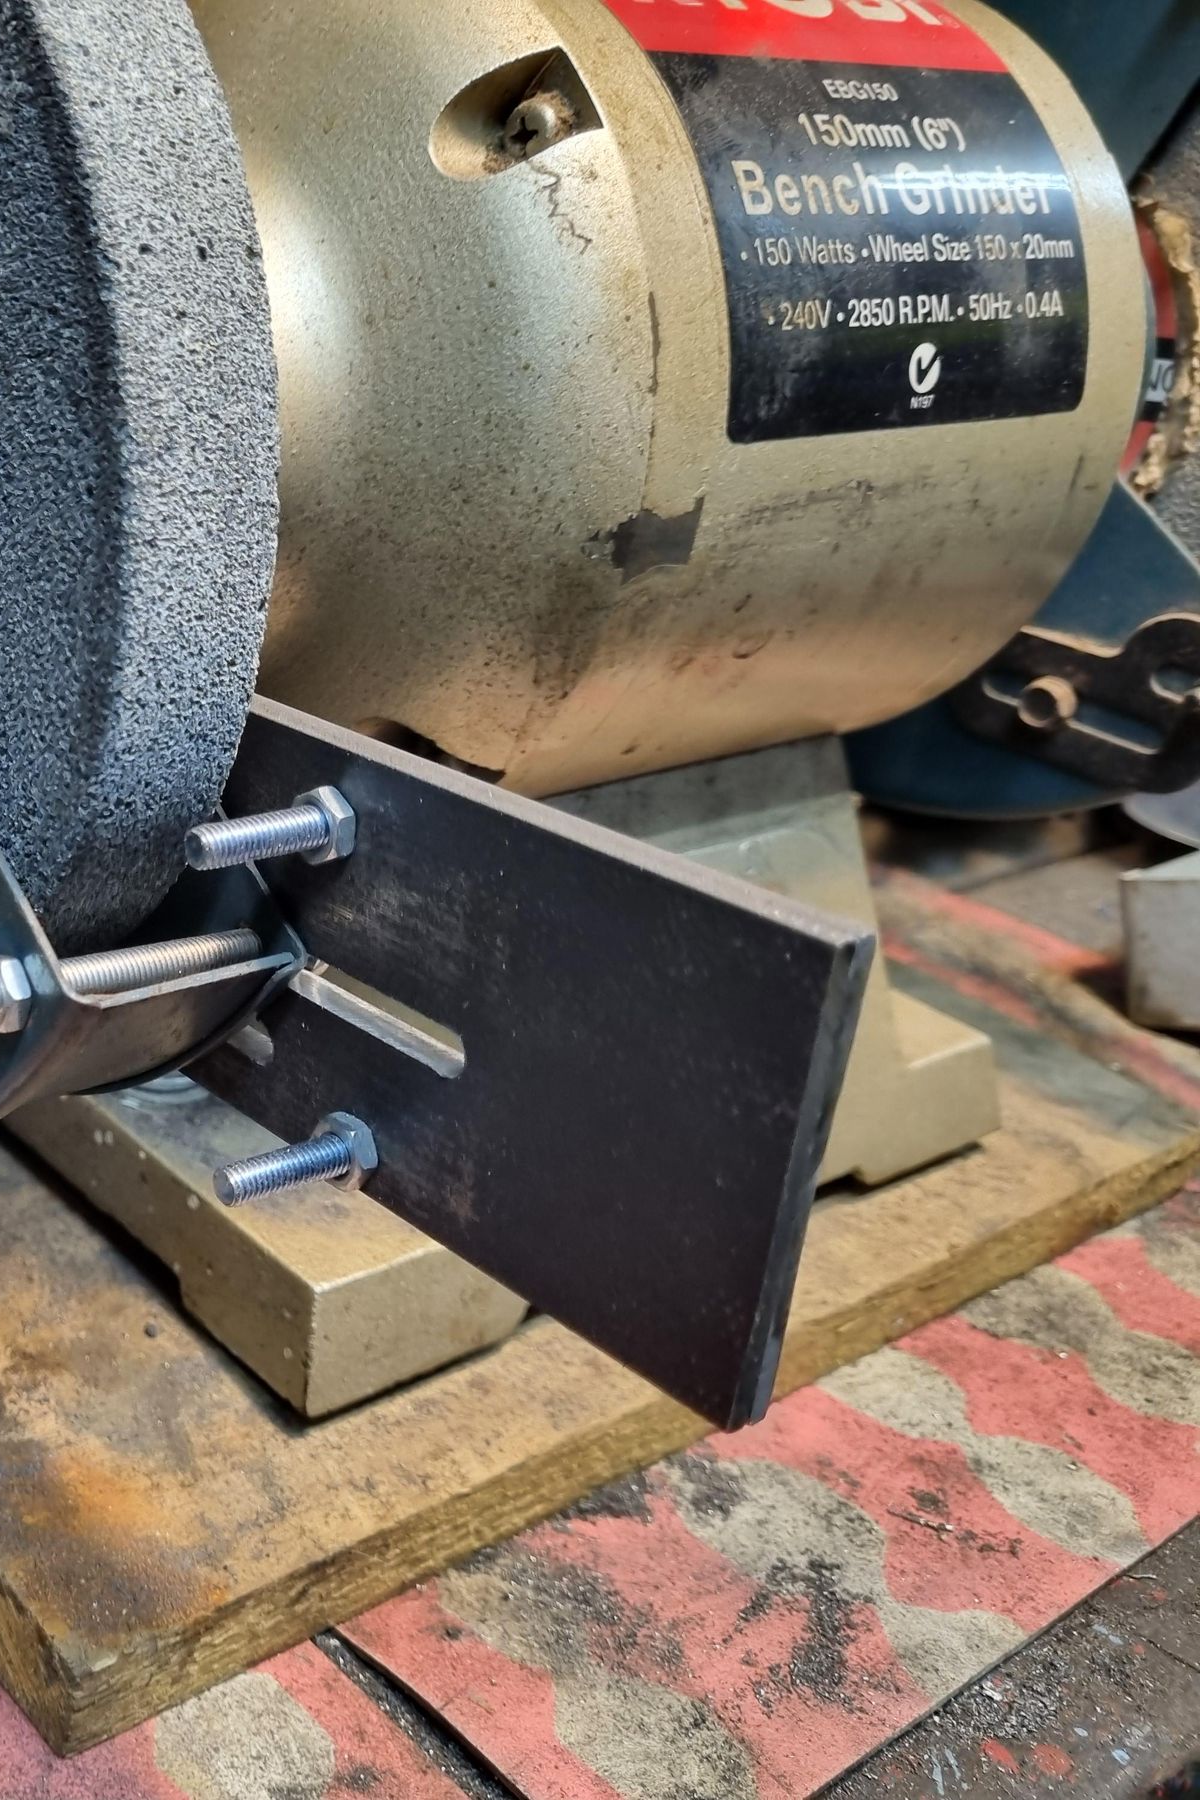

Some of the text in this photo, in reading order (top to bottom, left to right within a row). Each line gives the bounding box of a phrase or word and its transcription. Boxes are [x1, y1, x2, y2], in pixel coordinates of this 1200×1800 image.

[822, 78, 899, 102] EBG150
[798, 112, 911, 149] 150mm
[731, 160, 1051, 216] Bench Grinder
[754, 232, 1076, 267] 150 Watts Wheel Size 150 x 20mm
[778, 289, 1064, 331] 240V 2850 R.P.M. 50Hz 0.4A
